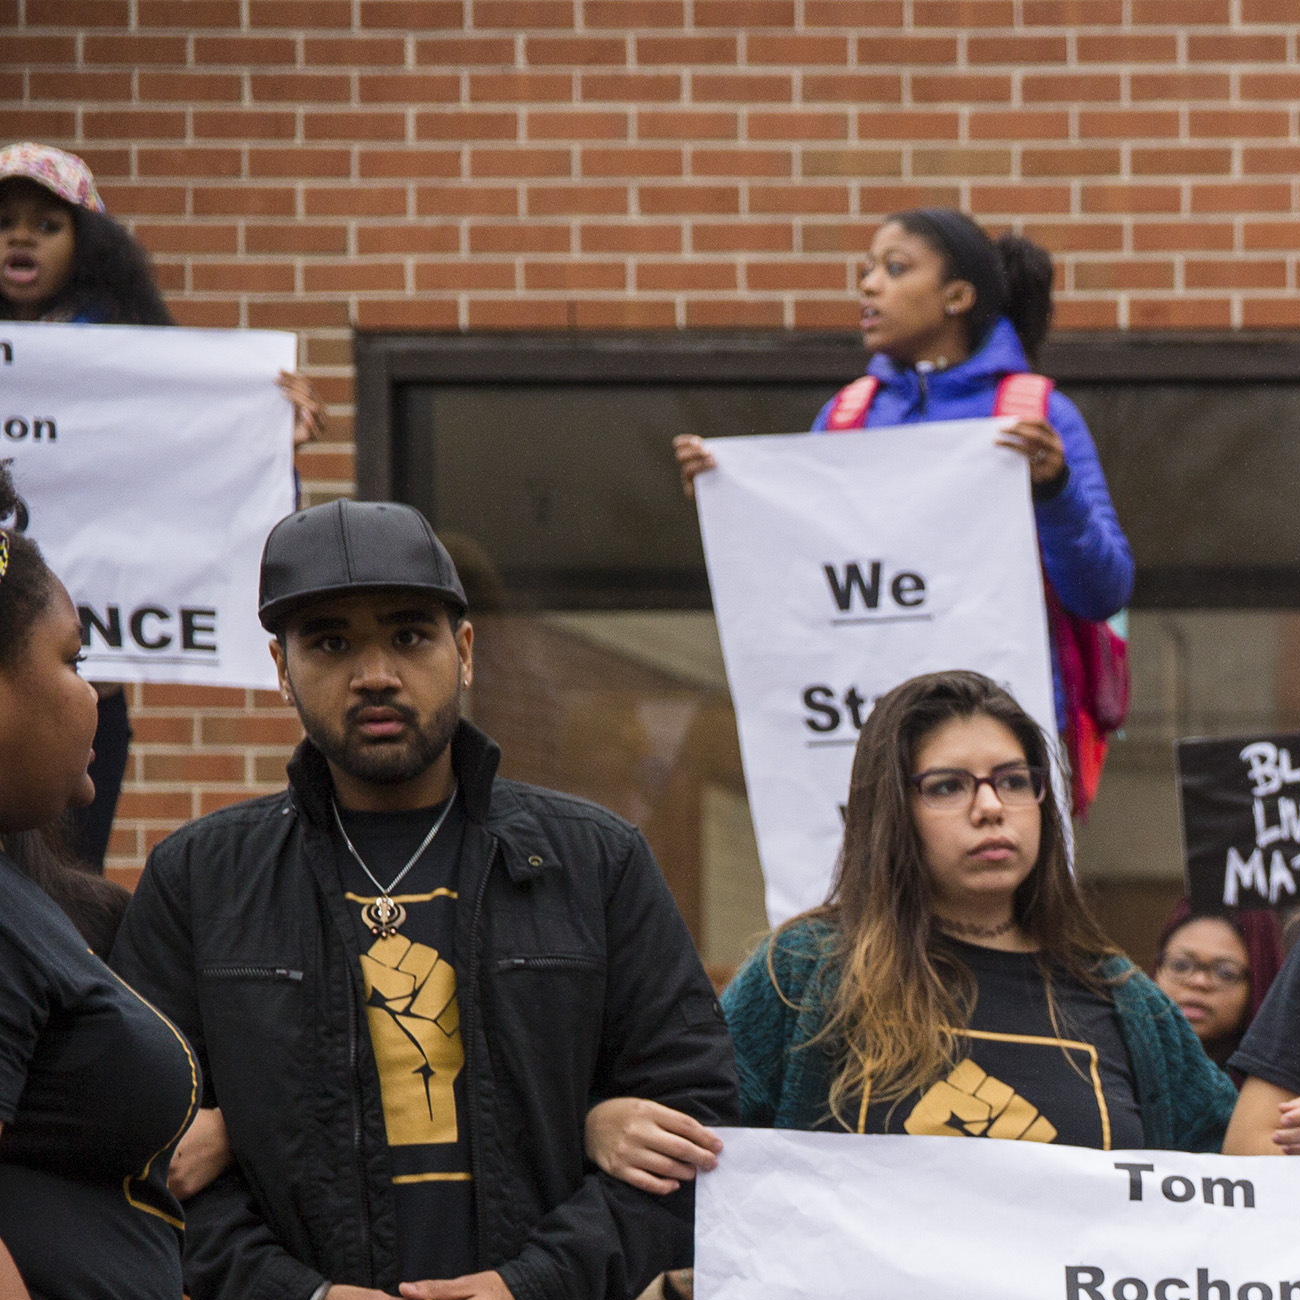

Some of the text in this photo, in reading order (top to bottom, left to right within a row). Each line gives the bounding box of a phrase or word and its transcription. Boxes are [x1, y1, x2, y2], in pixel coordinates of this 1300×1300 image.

[824, 561, 926, 611] We
[803, 685, 884, 732] St
[1115, 1164, 1255, 1208] Tom
